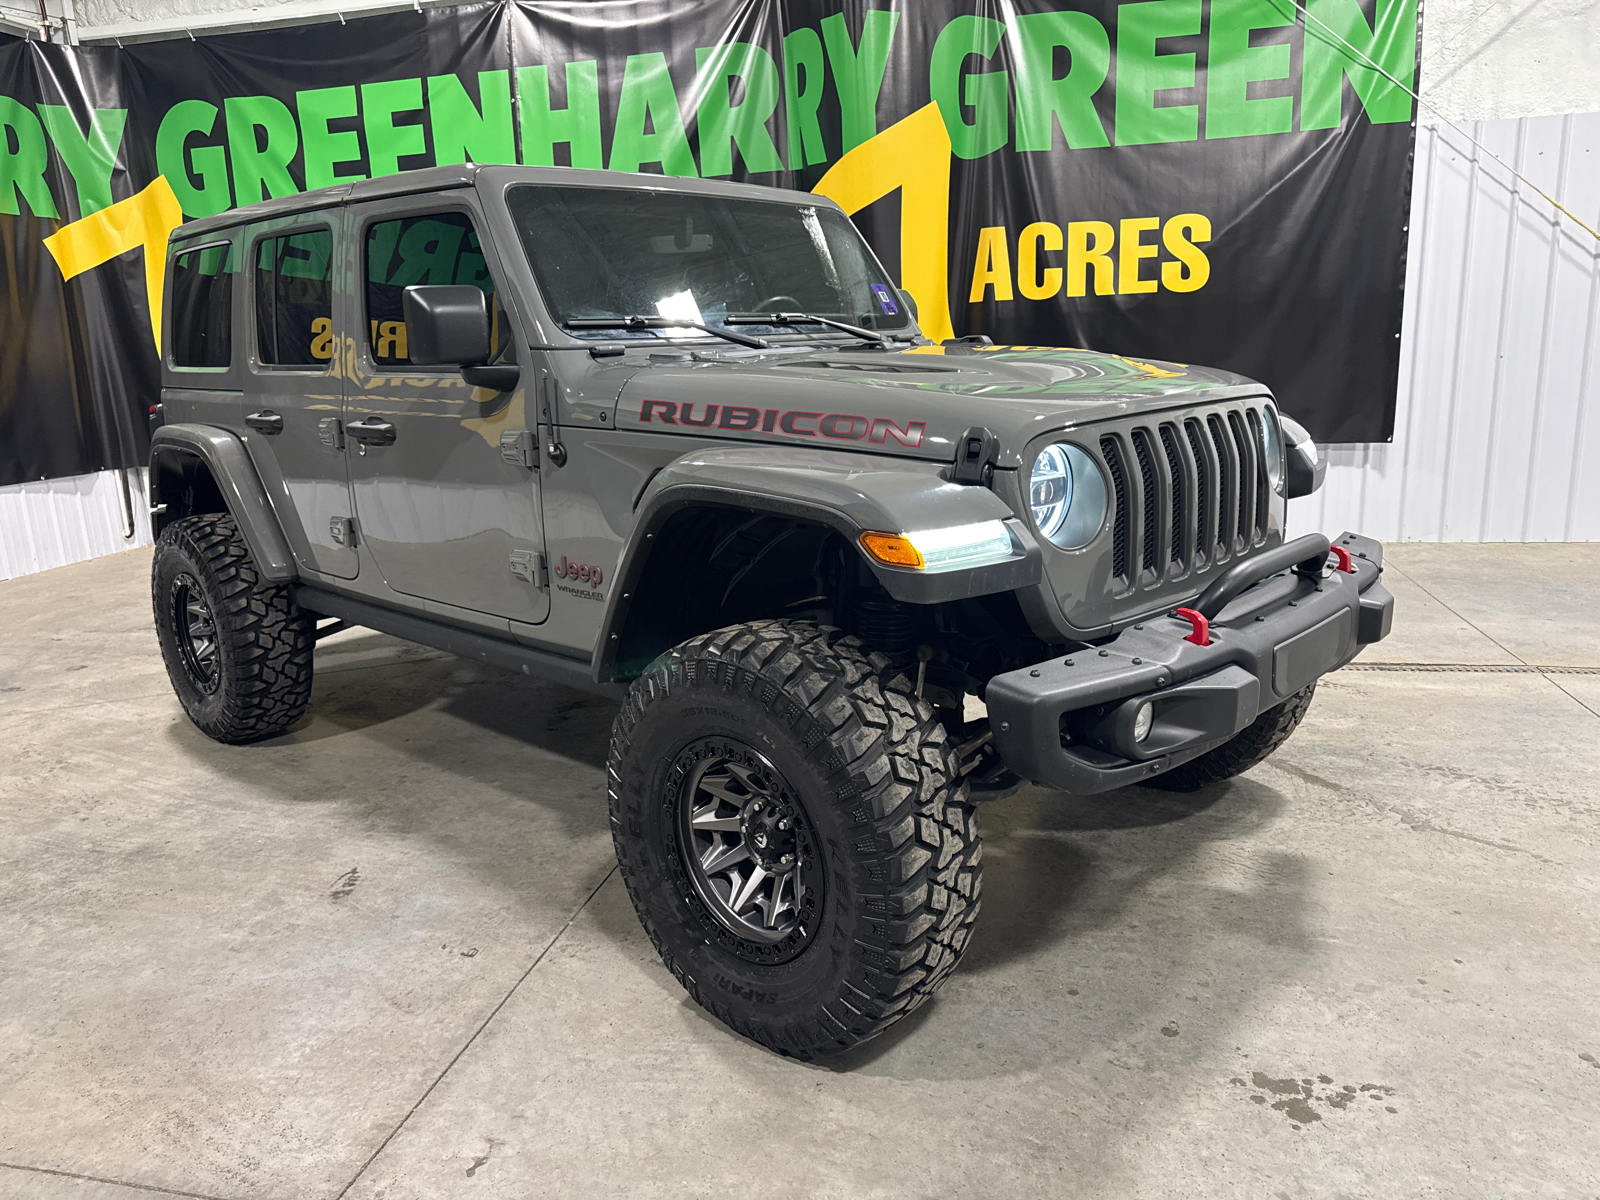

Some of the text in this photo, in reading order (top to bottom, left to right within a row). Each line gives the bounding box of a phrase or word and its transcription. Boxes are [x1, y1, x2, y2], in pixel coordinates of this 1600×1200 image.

[516, 0, 1417, 178] HARRY GREEN
[156, 69, 516, 218] GREEN
[968, 213, 1212, 303] ACRES
[639, 399, 927, 448] RUBICON
[553, 555, 603, 589] Jeep
[556, 584, 604, 599] WRANGLER
